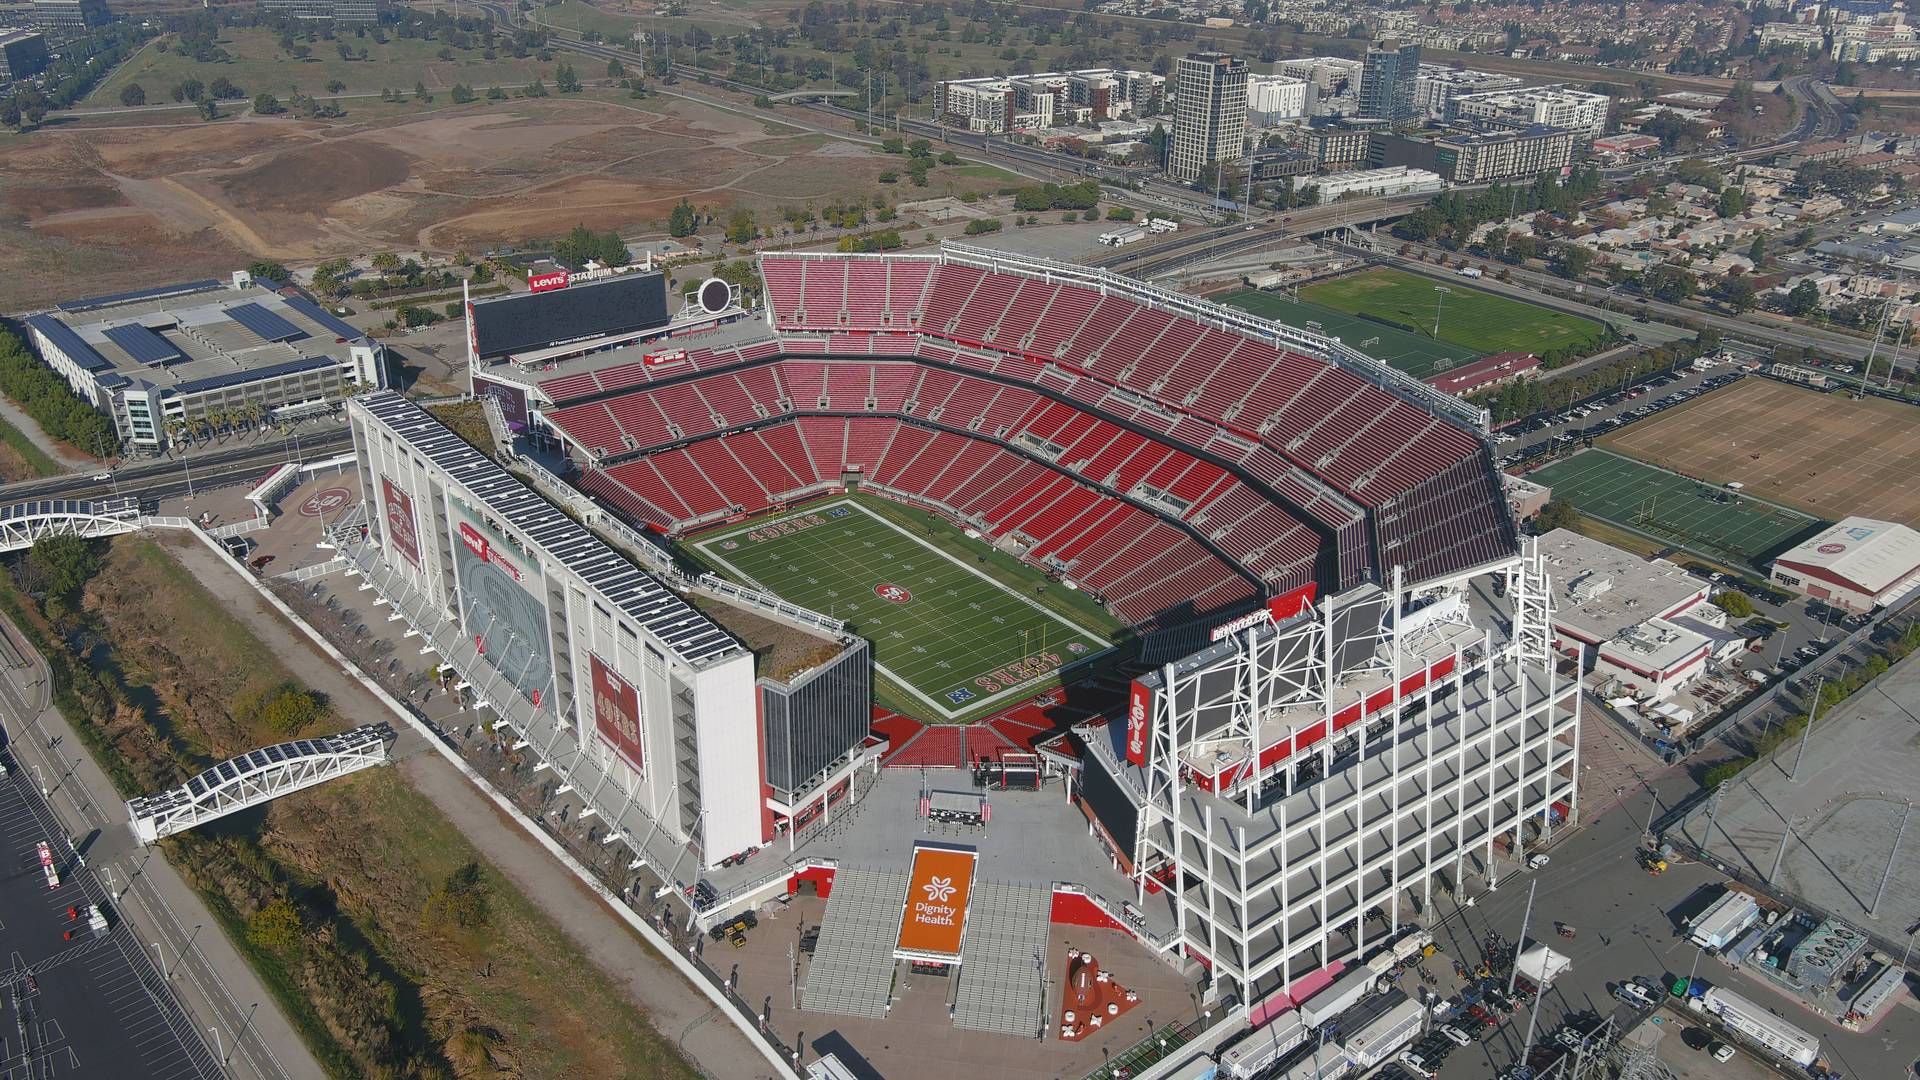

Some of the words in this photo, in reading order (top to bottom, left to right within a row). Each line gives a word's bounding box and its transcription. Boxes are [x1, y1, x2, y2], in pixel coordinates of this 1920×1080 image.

[569, 268, 612, 282] STADIUM
[748, 514, 826, 543] 49ERS
[597, 691, 639, 746] 49ERS
[915, 902, 956, 917] Dignity
